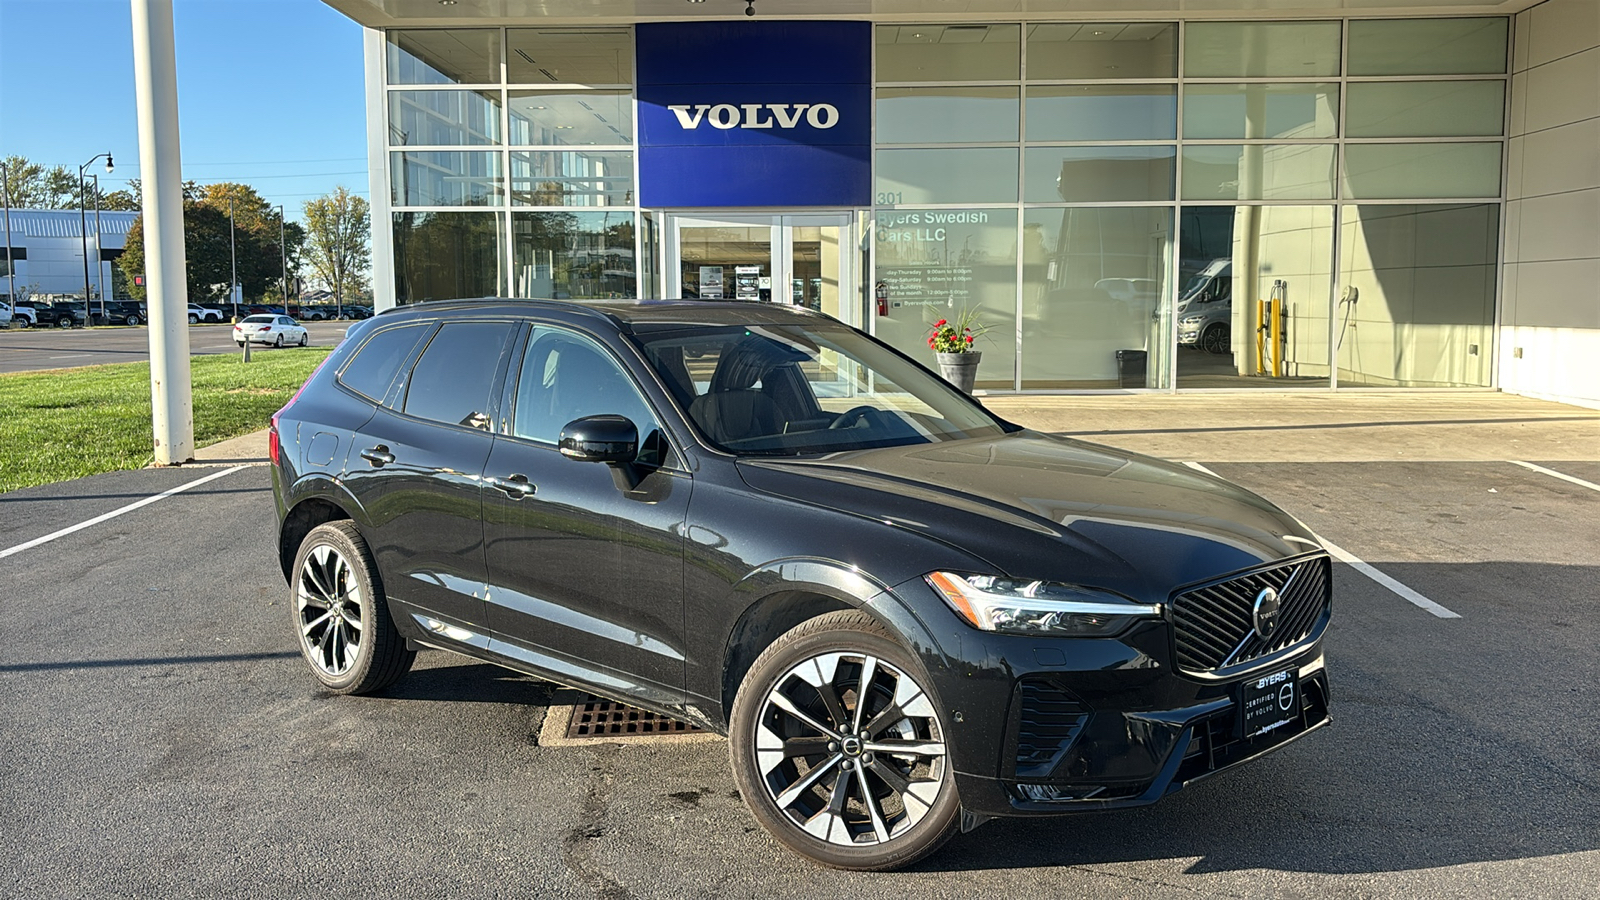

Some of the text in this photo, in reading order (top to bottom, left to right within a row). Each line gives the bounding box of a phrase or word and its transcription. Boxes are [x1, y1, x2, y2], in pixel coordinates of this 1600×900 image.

[667, 104, 839, 129] VOLVO
[877, 192, 903, 204] 301
[877, 212, 988, 227] Byers Swedish
[877, 228, 946, 242] Cars LLC
[1258, 671, 1287, 688] BYERS
[1246, 704, 1274, 720] BY VOLVO
